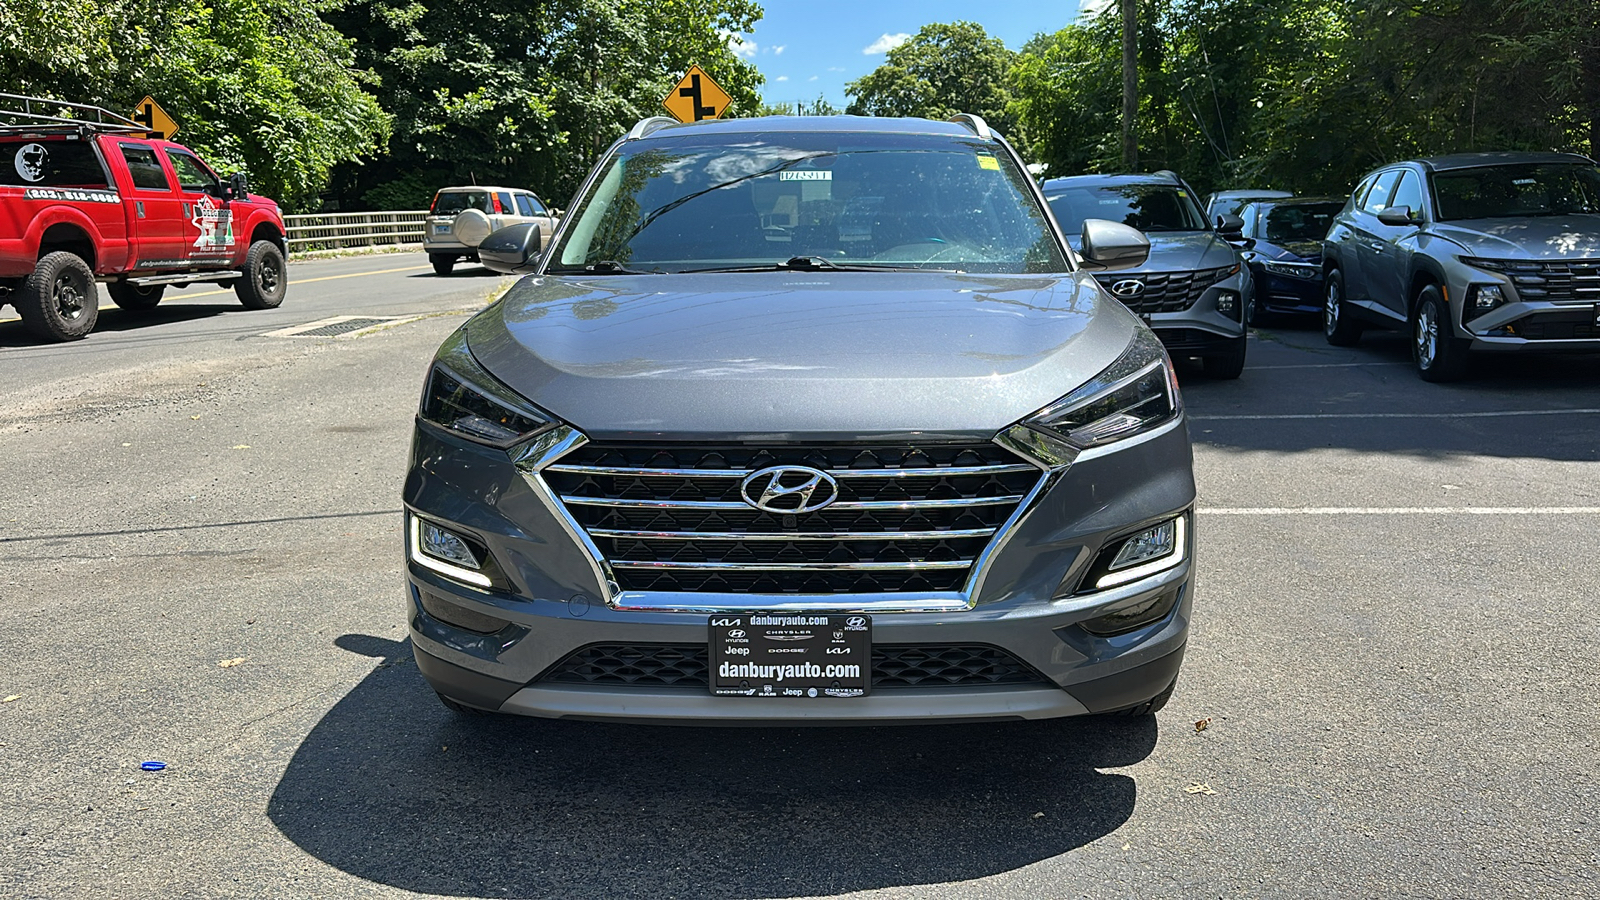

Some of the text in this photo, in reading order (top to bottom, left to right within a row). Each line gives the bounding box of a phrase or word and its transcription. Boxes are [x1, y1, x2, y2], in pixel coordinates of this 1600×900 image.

[750, 615, 829, 627] danburyauto.com
[724, 646, 750, 656] Jeep
[719, 661, 860, 681] danburyauto.com
[782, 687, 803, 697] Jeep
